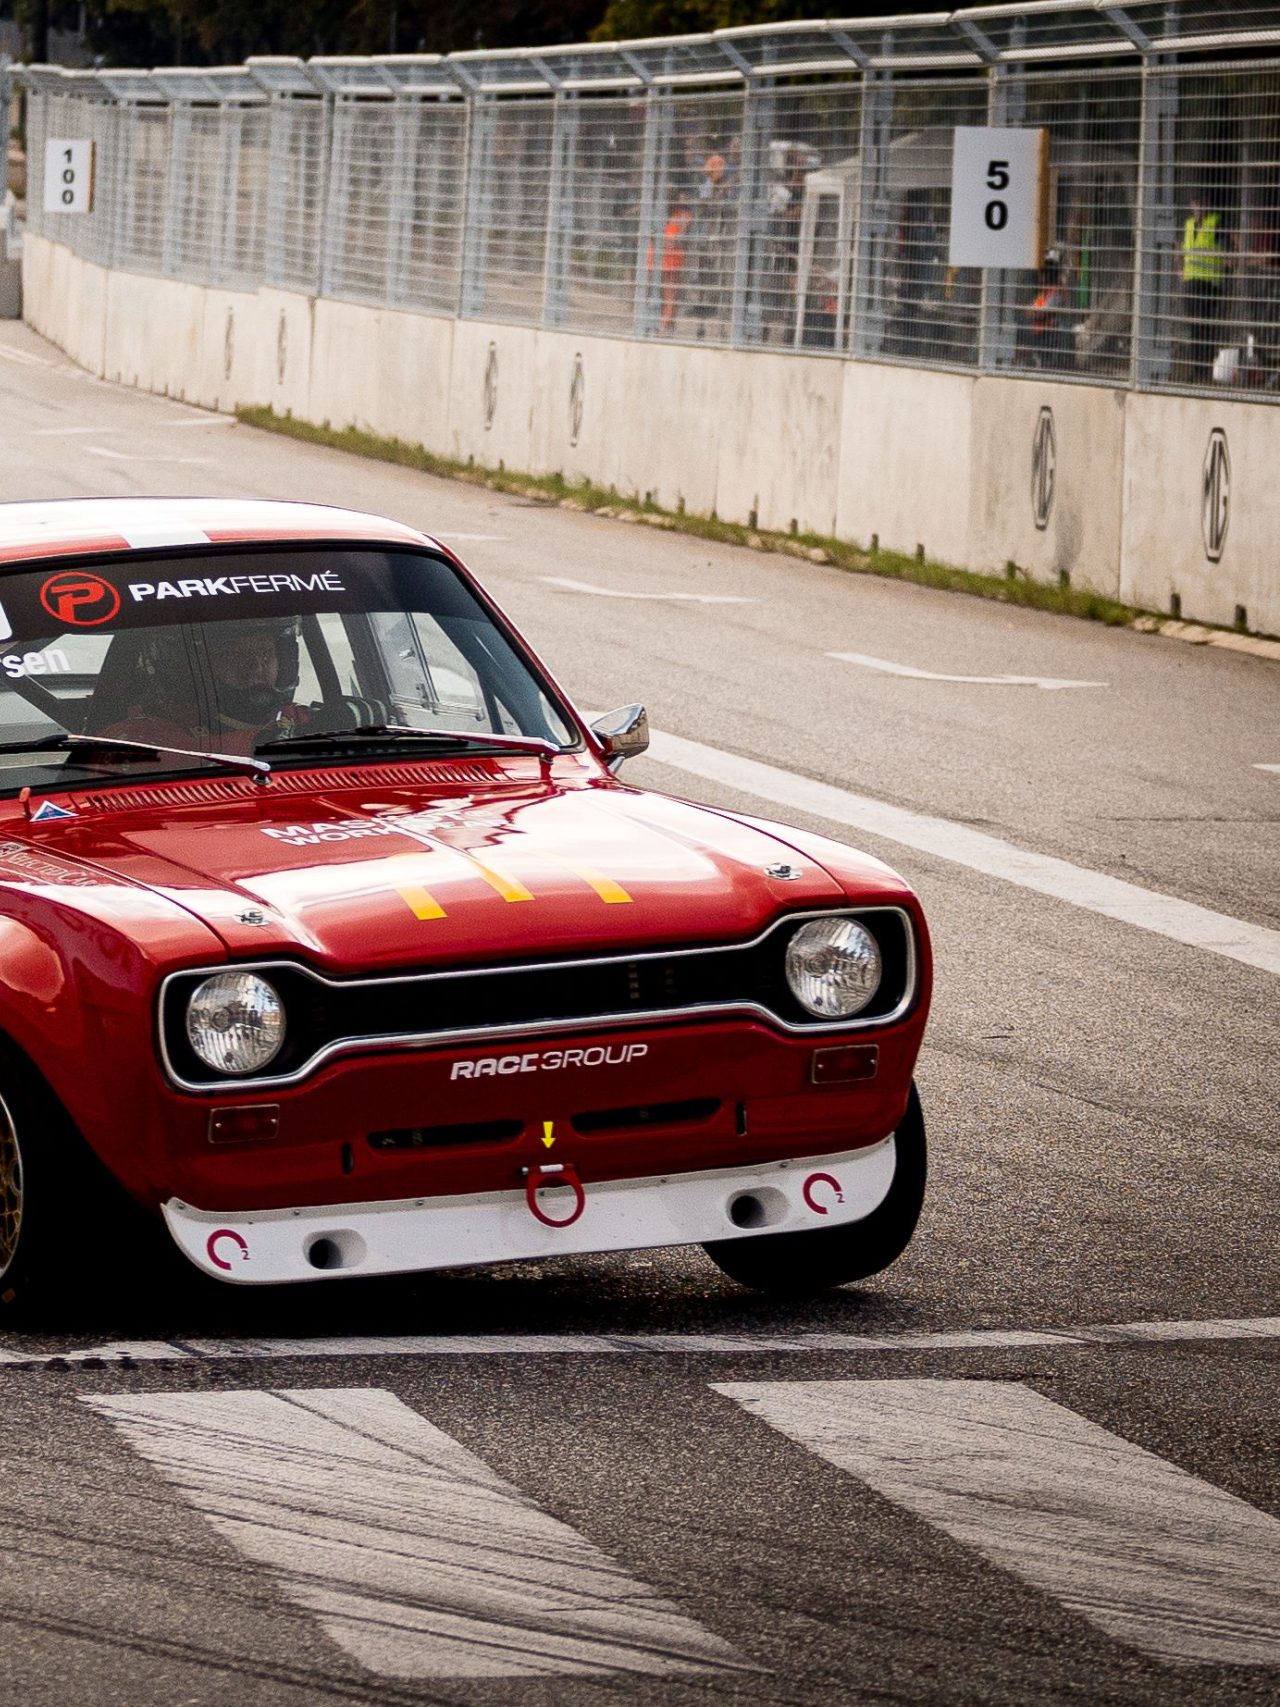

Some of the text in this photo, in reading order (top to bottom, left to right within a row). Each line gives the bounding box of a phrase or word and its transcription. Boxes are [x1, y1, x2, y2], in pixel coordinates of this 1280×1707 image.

[62, 149, 75, 204] 100
[985, 160, 1010, 231] 50
[128, 570, 345, 601] PARKFERMÉ
[450, 1044, 648, 1080] RACEGROUP
